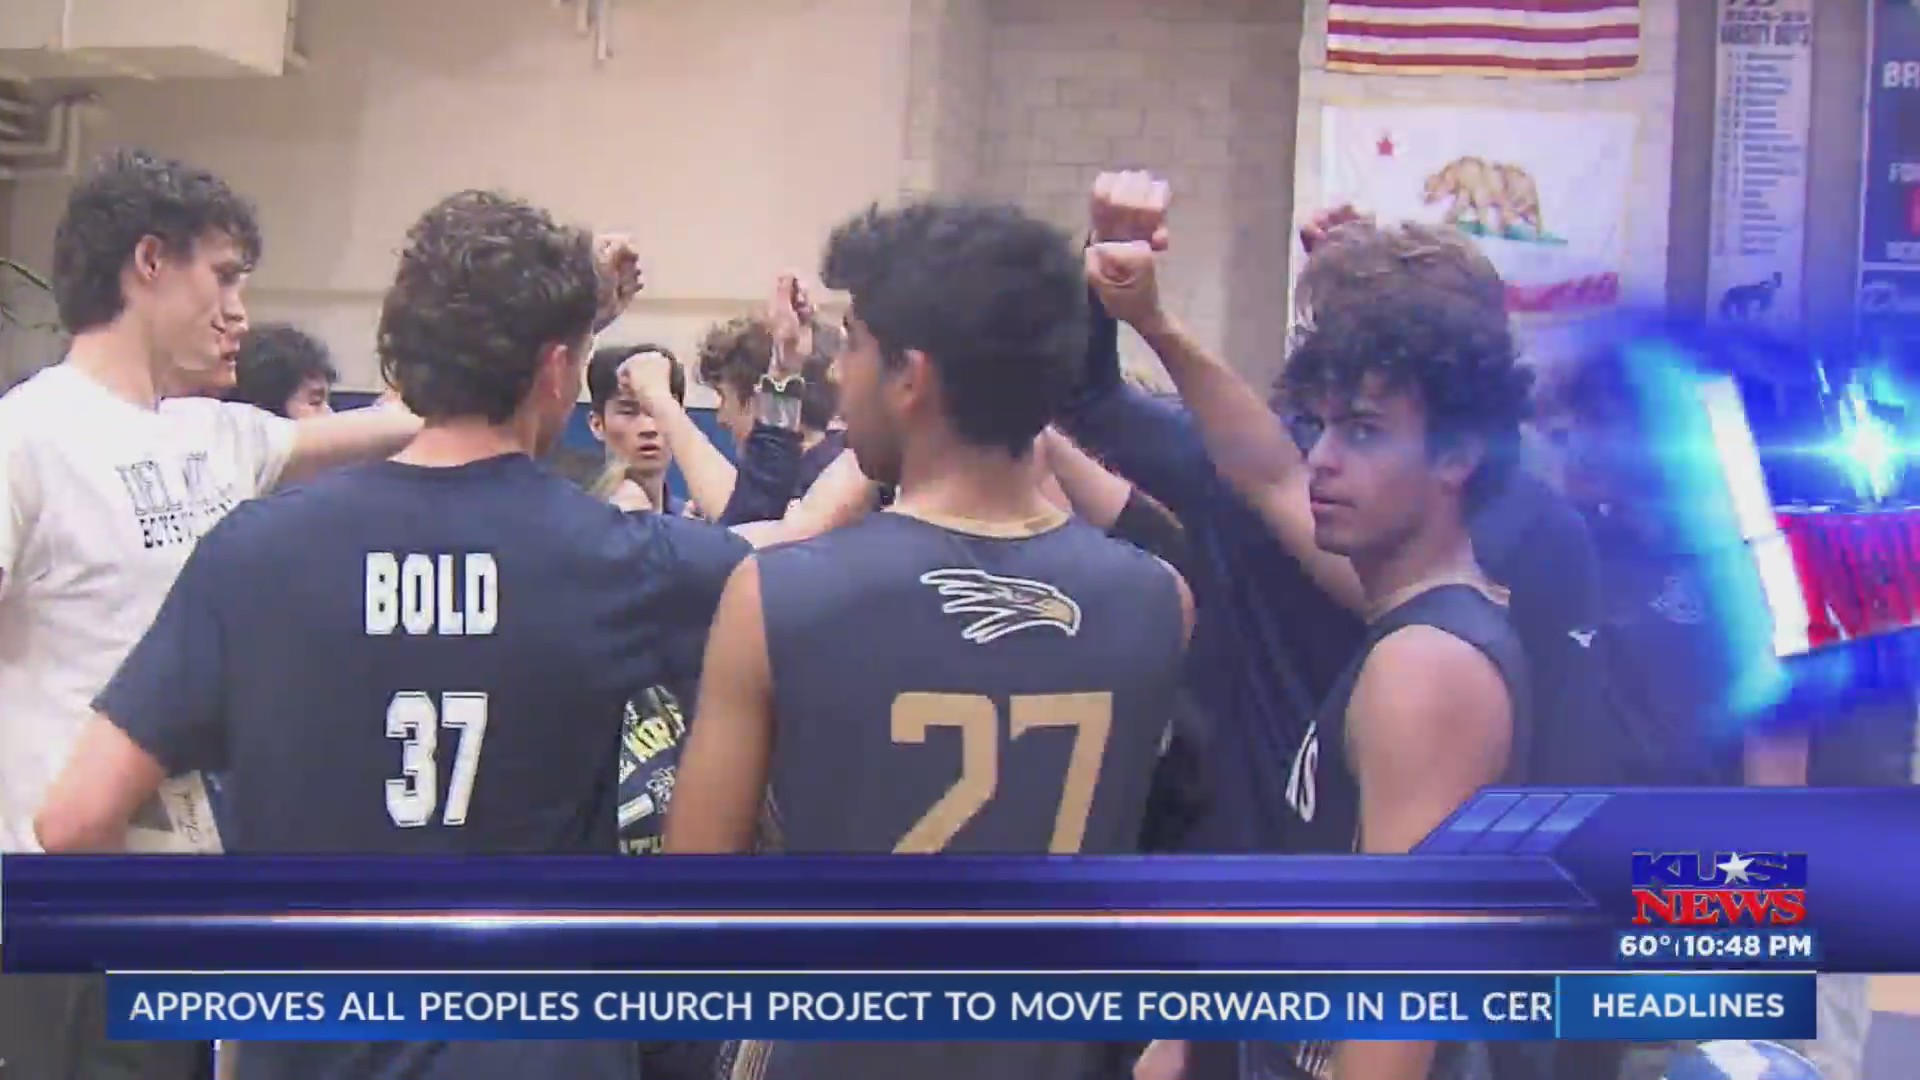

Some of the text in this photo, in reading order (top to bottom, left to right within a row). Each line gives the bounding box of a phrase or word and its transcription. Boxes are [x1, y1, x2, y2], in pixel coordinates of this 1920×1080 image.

[365, 552, 498, 635] BOLD
[385, 691, 489, 828] 37
[891, 691, 1112, 855] 27
